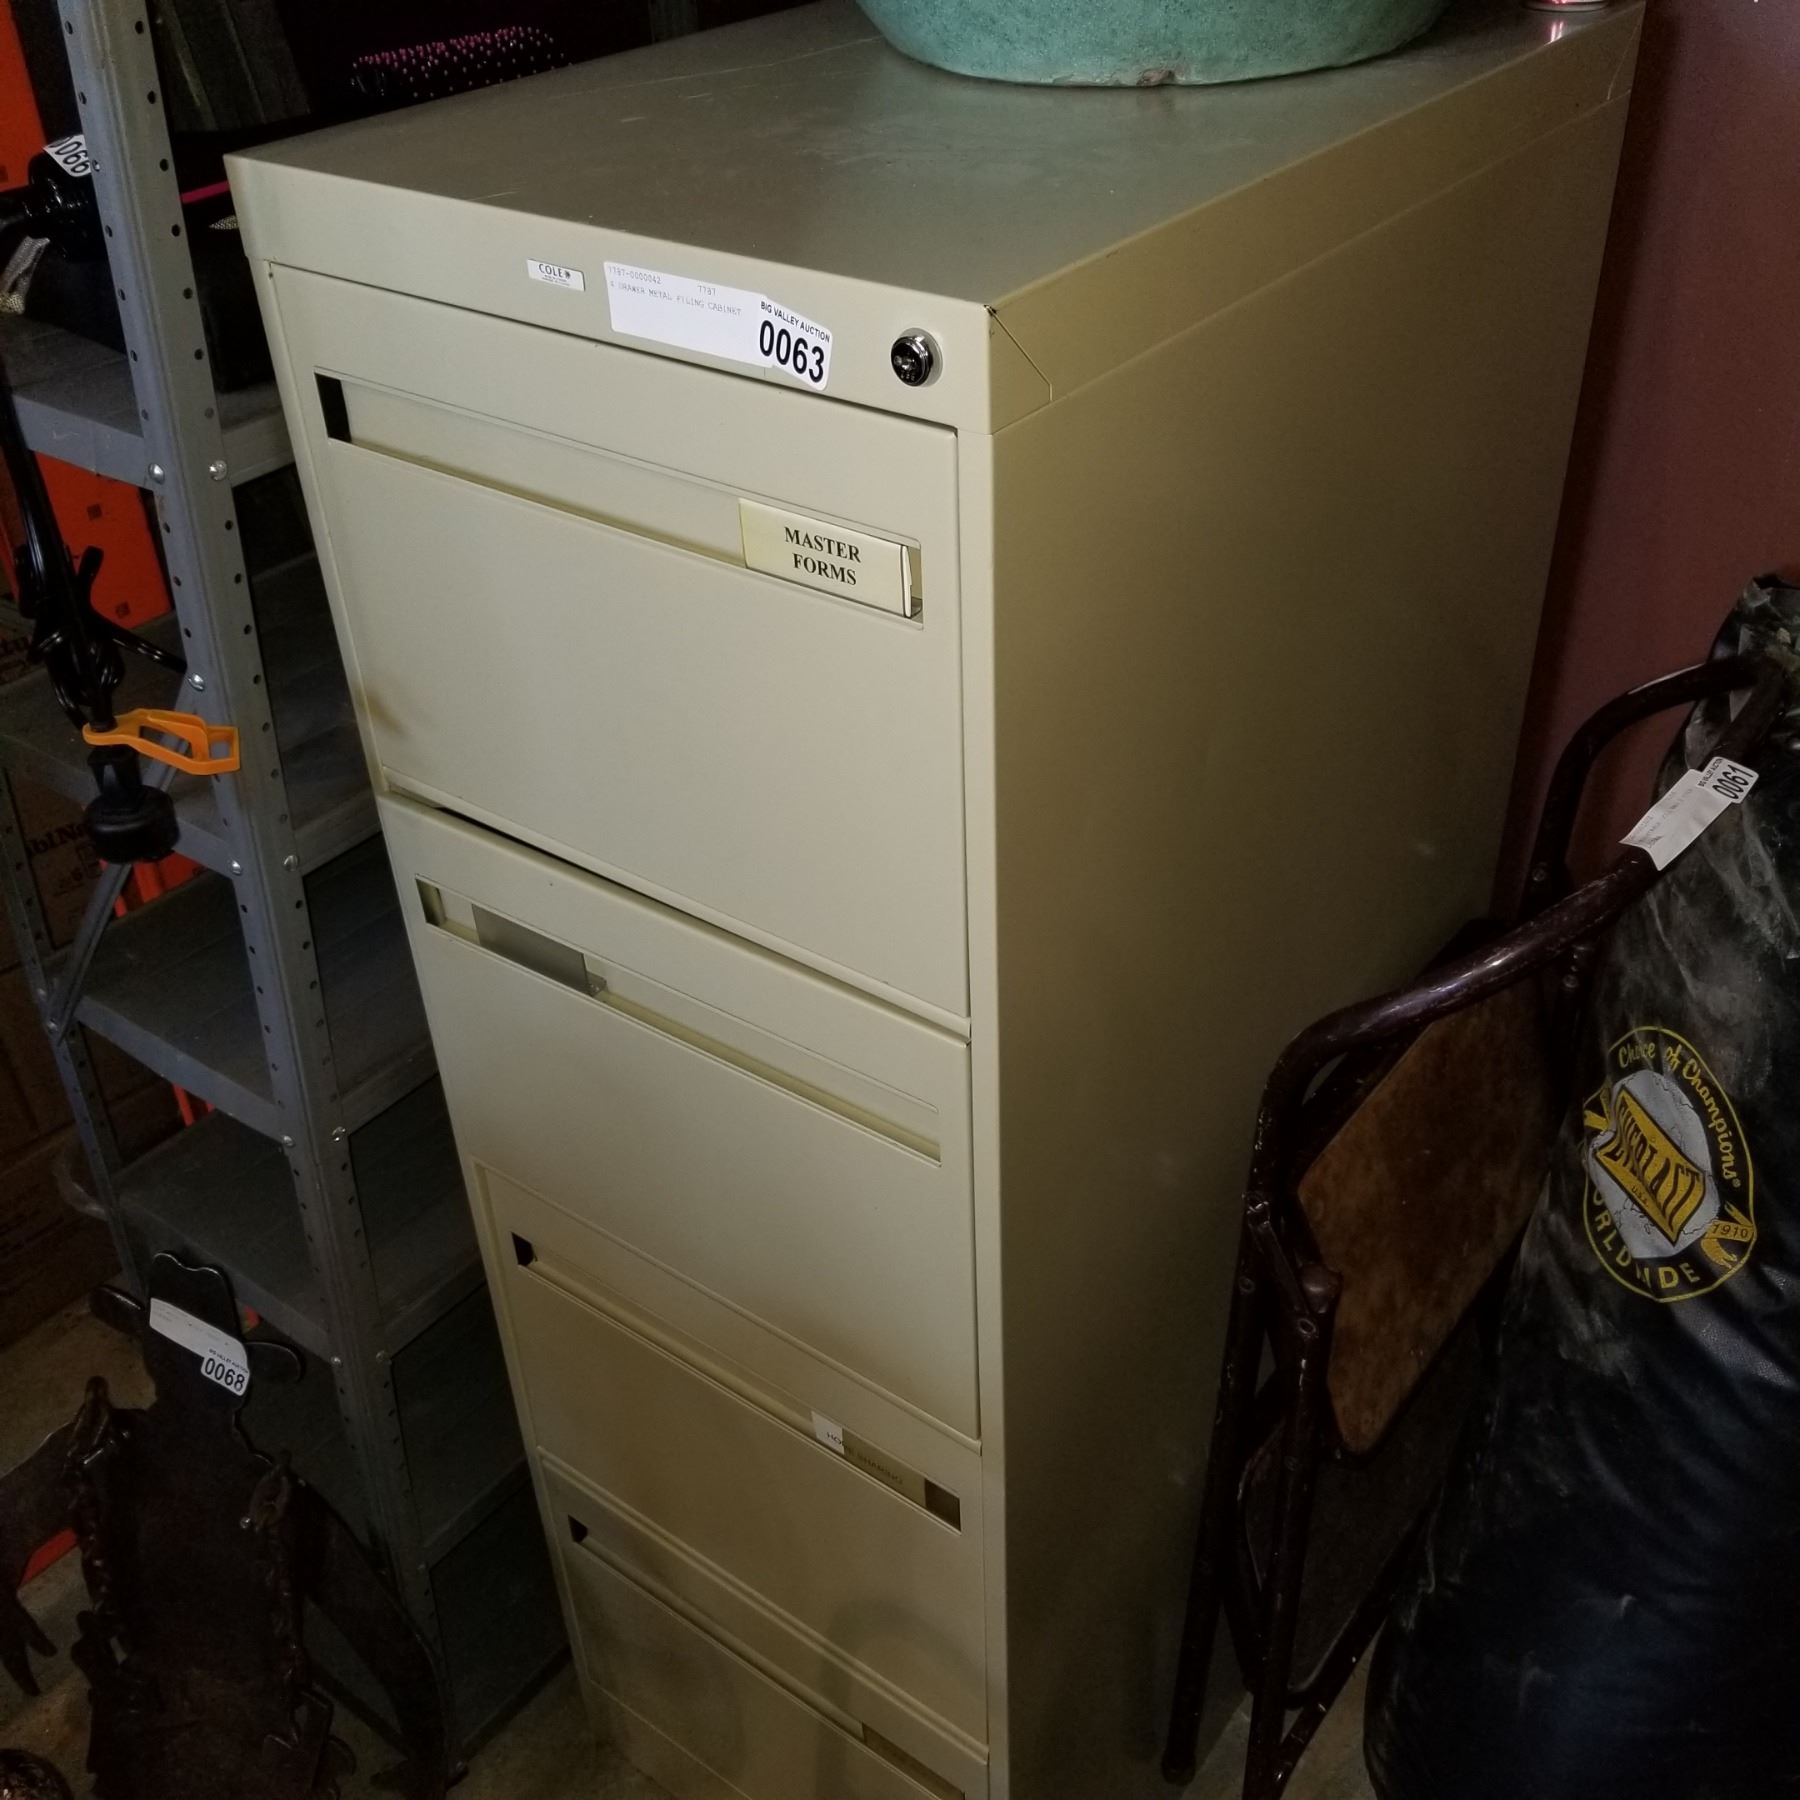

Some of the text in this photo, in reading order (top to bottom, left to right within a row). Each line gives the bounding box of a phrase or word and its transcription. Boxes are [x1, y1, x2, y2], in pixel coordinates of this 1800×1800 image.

[538, 263, 564, 278] COLE
[648, 288, 673, 302] METAL
[707, 302, 742, 317] CABINET
[760, 300, 831, 344] BIG VALLEY AUCTION
[759, 319, 825, 384] 0063
[783, 526, 862, 564] MASTER
[792, 552, 858, 586] FORMS
[1711, 763, 1754, 800] 0061
[1711, 1223, 1750, 1240] 1910
[204, 1356, 246, 1392] 0068
